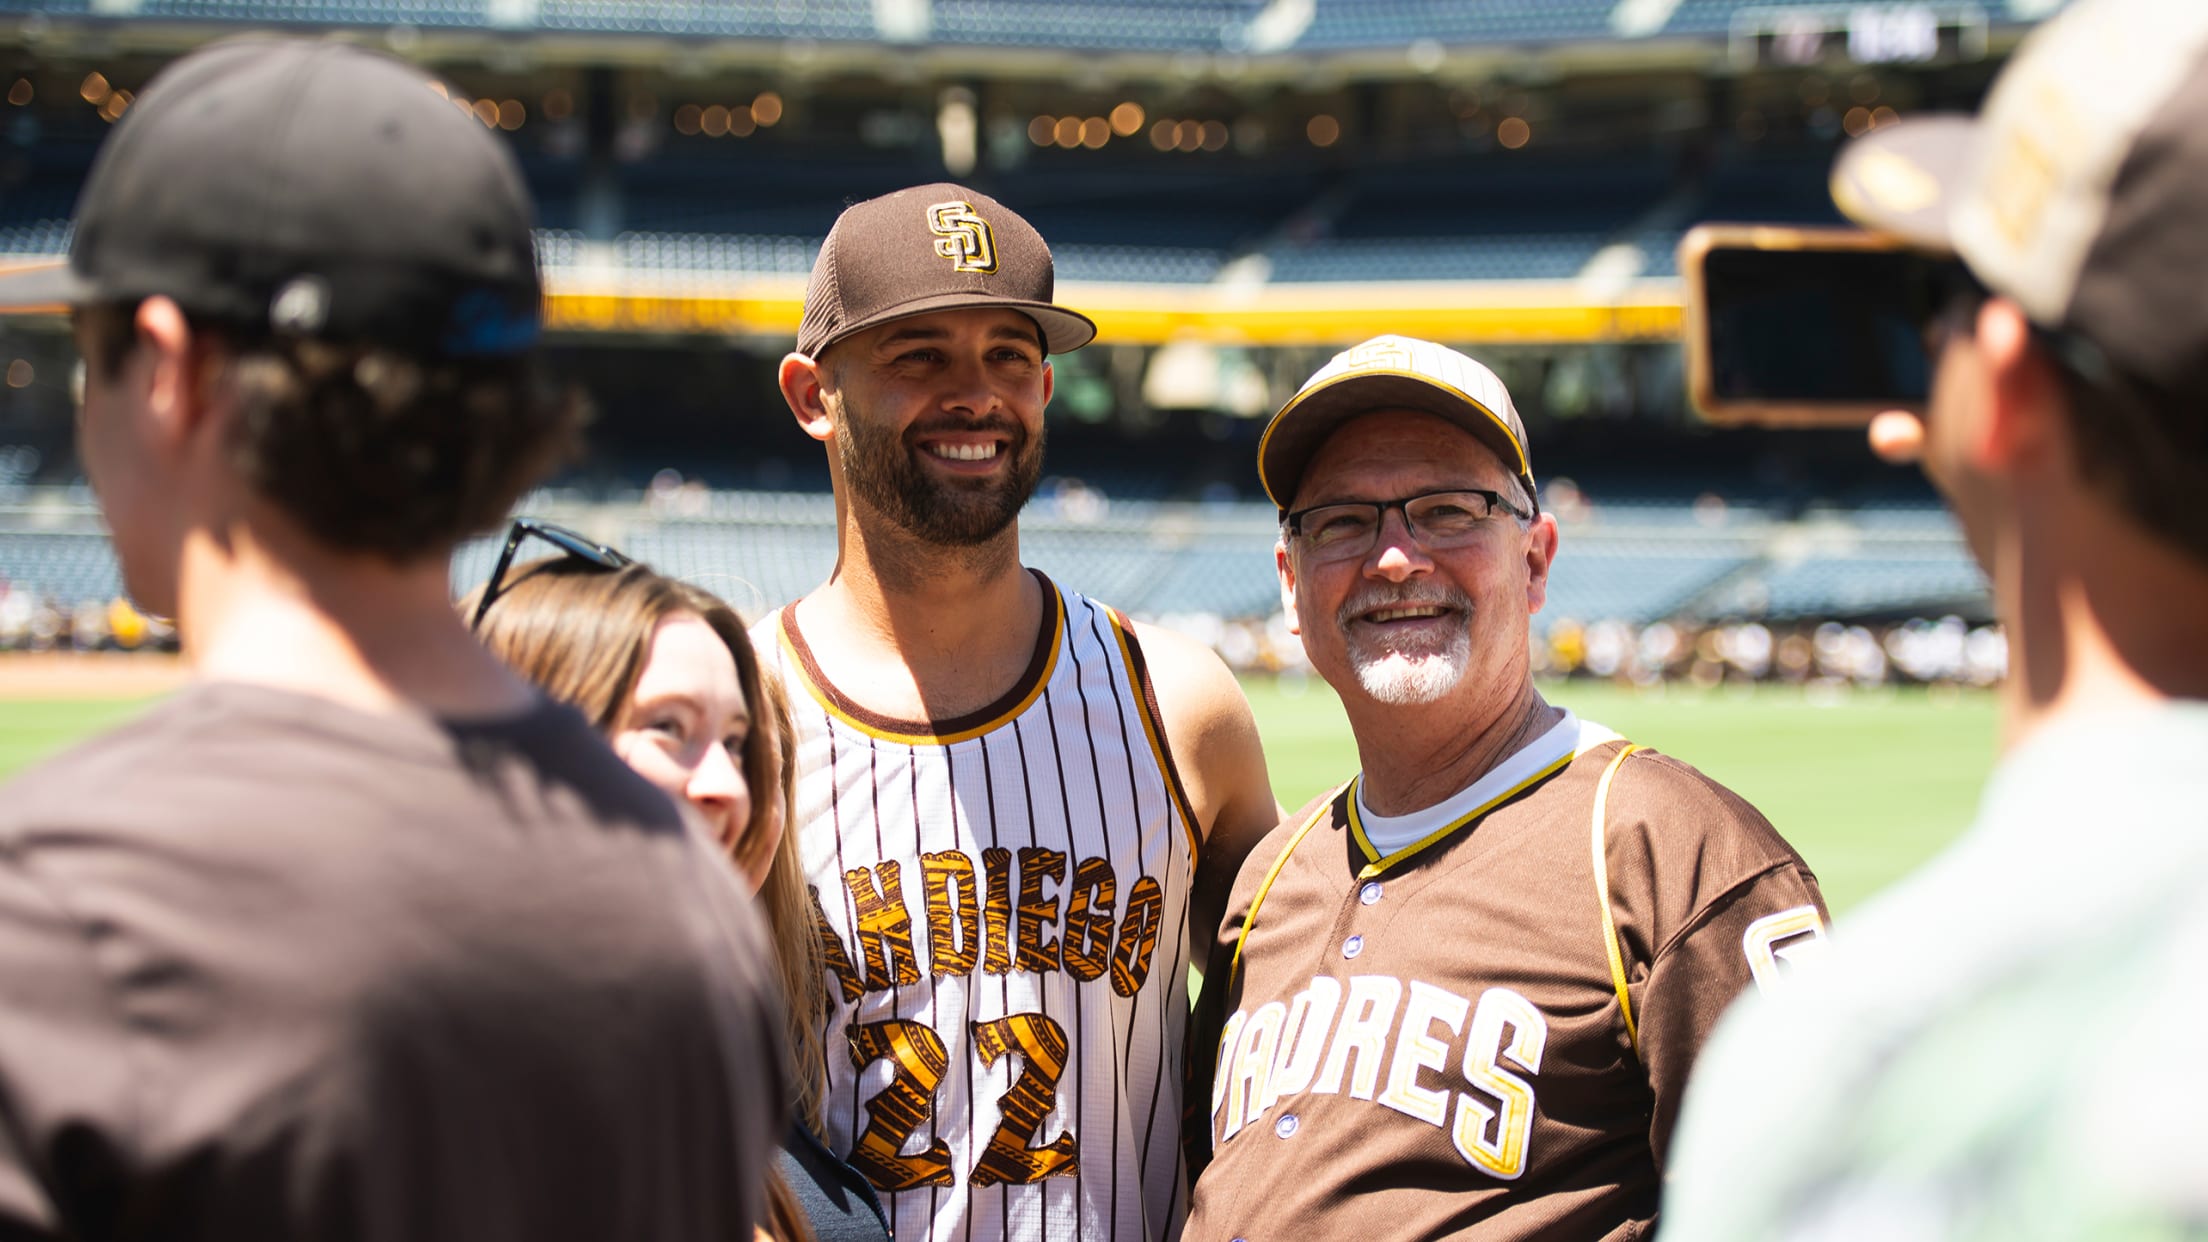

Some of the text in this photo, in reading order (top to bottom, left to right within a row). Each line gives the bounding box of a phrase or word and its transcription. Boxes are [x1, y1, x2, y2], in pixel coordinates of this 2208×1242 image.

[927, 200, 999, 275] SD
[846, 1012, 1081, 1192] 22
[1212, 974, 1548, 1181] PADRES
